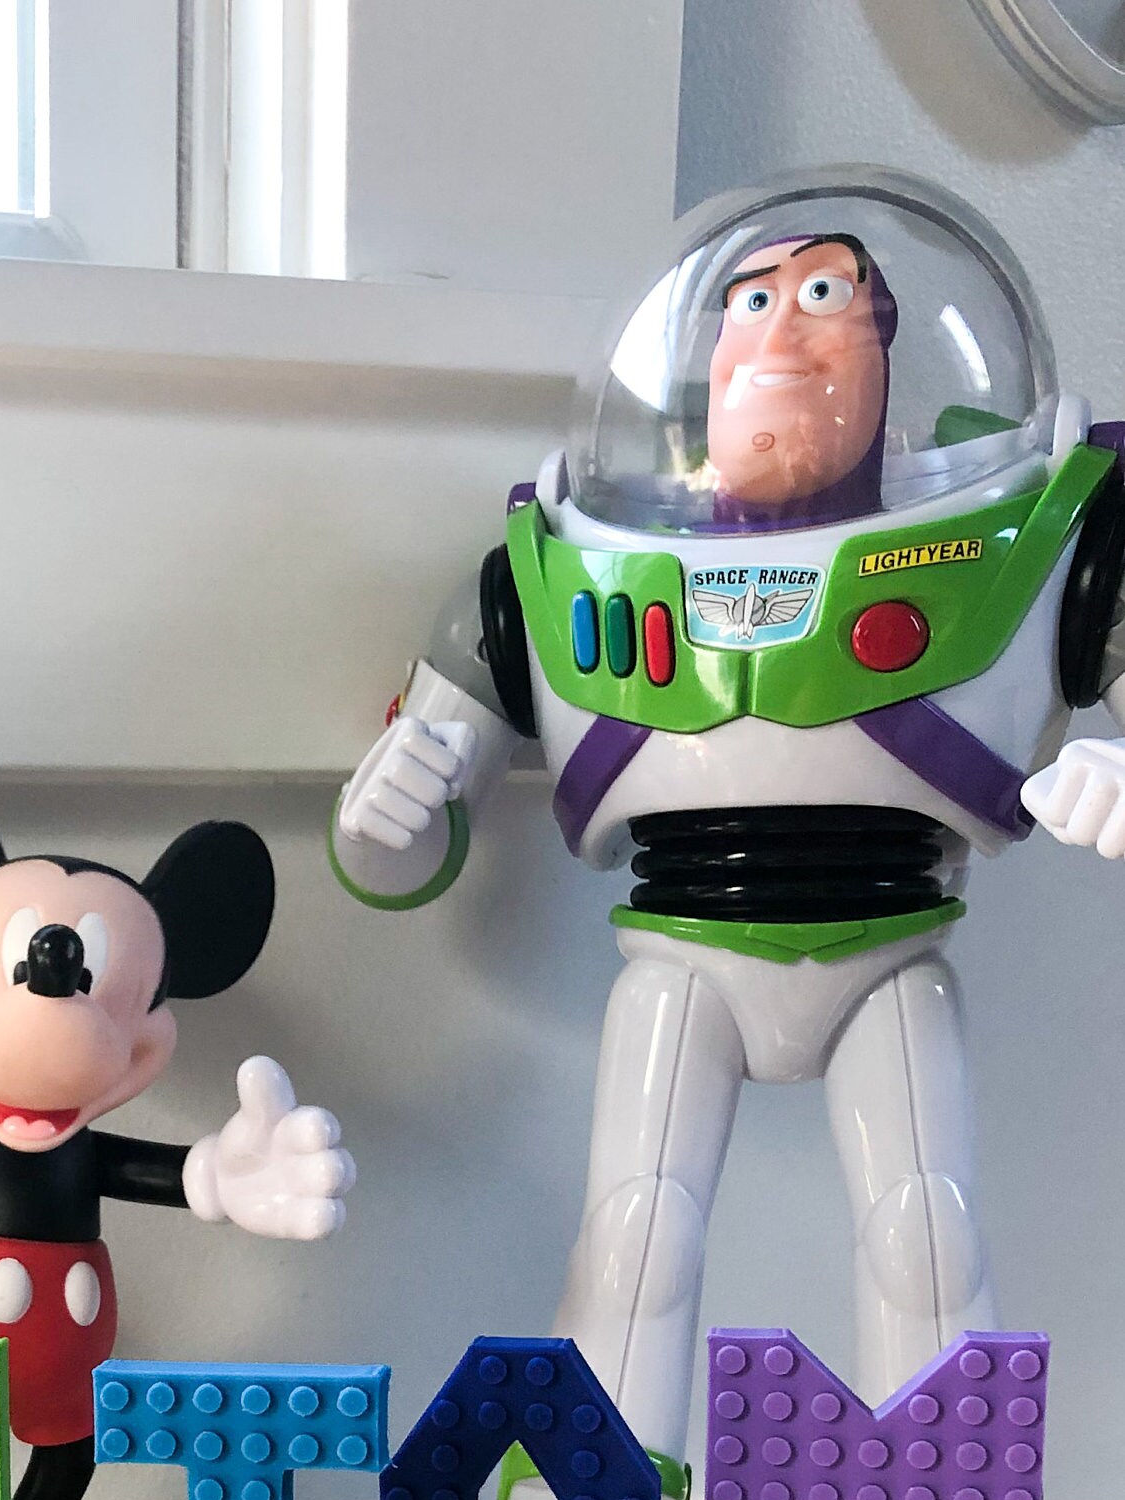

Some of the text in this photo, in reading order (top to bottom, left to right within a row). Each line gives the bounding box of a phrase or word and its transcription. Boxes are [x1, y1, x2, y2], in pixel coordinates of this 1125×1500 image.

[860, 540, 981, 575] LIGHTYEAR
[694, 568, 820, 586] SPACE RANGER
